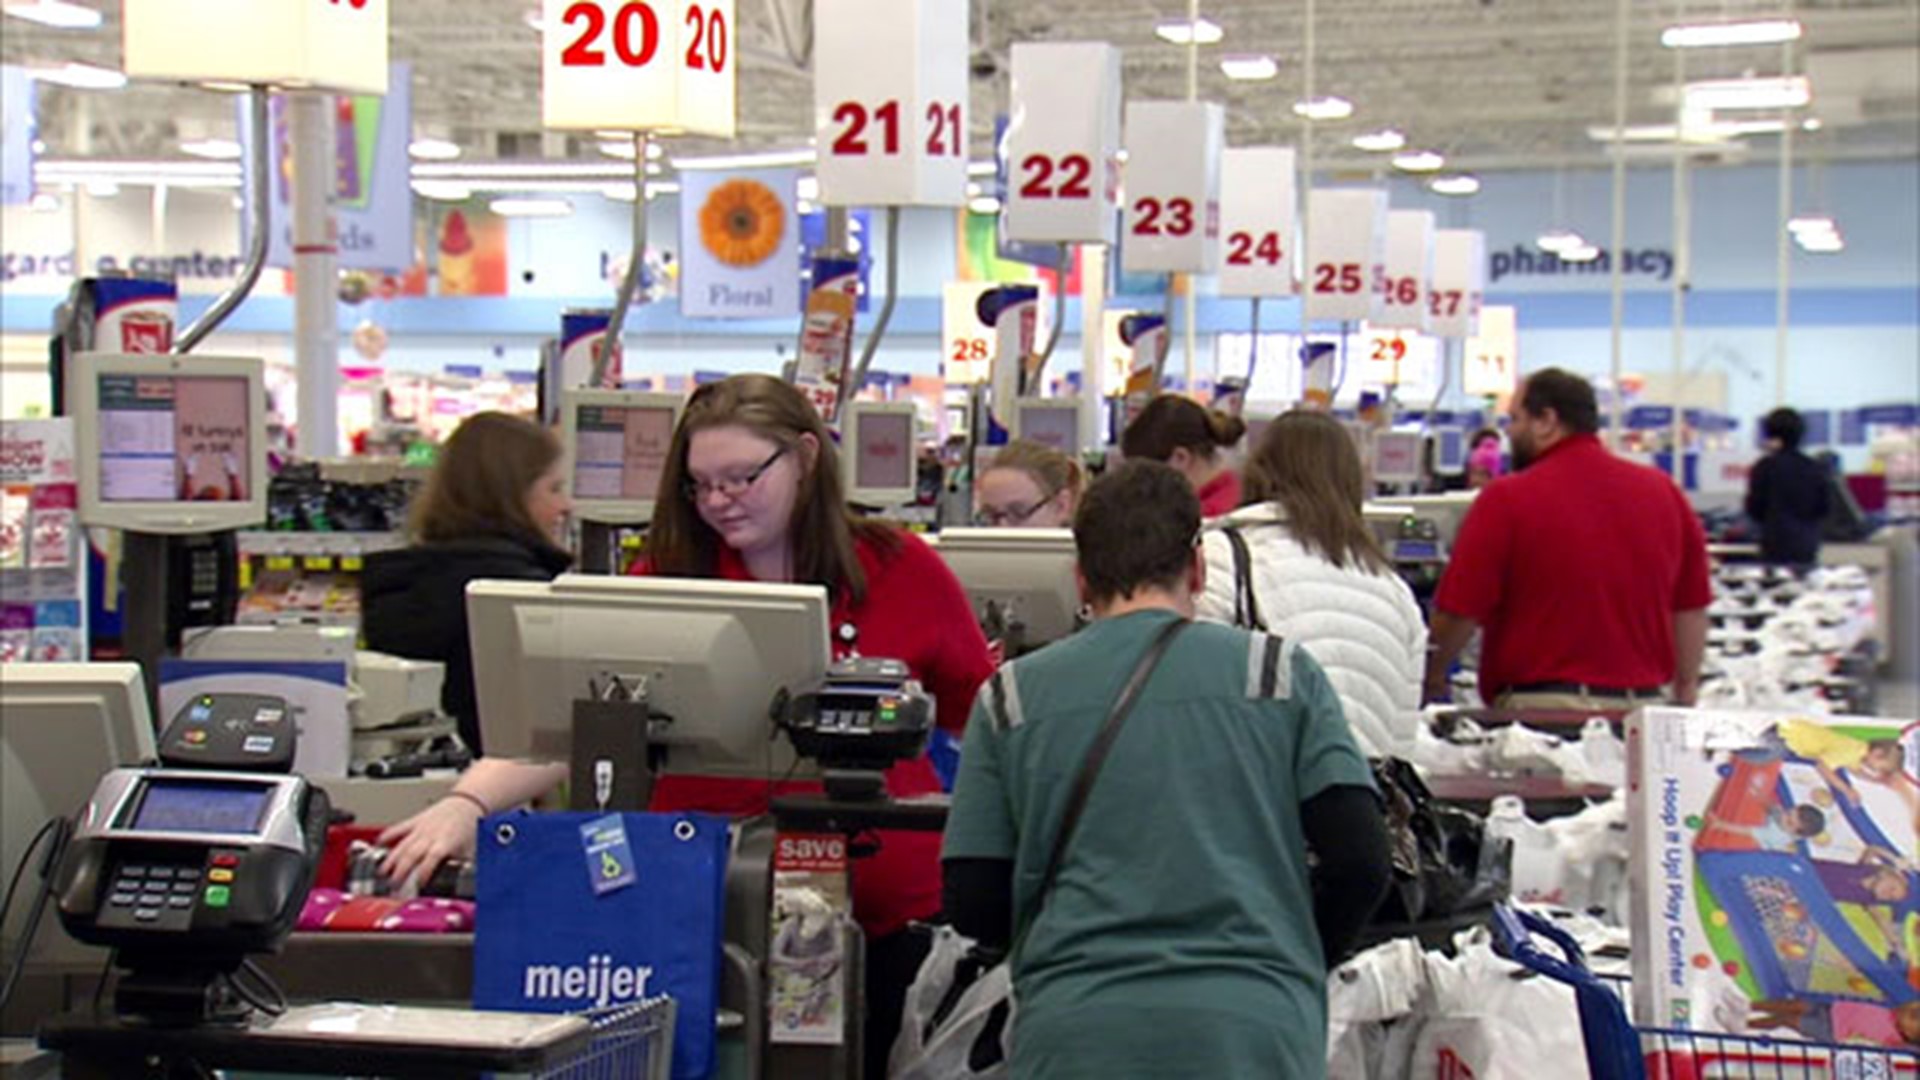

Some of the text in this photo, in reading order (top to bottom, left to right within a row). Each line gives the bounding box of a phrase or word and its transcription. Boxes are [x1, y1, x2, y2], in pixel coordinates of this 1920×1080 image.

[560, 1, 658, 67] 20
[685, 4, 726, 72] 20
[832, 101, 898, 155] 21
[926, 102, 960, 156] 21
[1019, 155, 1091, 198] 22
[1132, 197, 1193, 237] 23
[1226, 232, 1282, 265] 24
[709, 283, 773, 307] Floral
[1314, 263, 1361, 293] 25
[952, 339, 988, 361] 28
[1371, 338, 1406, 361] 29
[1660, 778, 1680, 826] Hoop
[780, 838, 845, 859] save
[1663, 883, 1686, 921] Play
[1668, 926, 1685, 988] Center
[525, 955, 651, 1006] meijer
